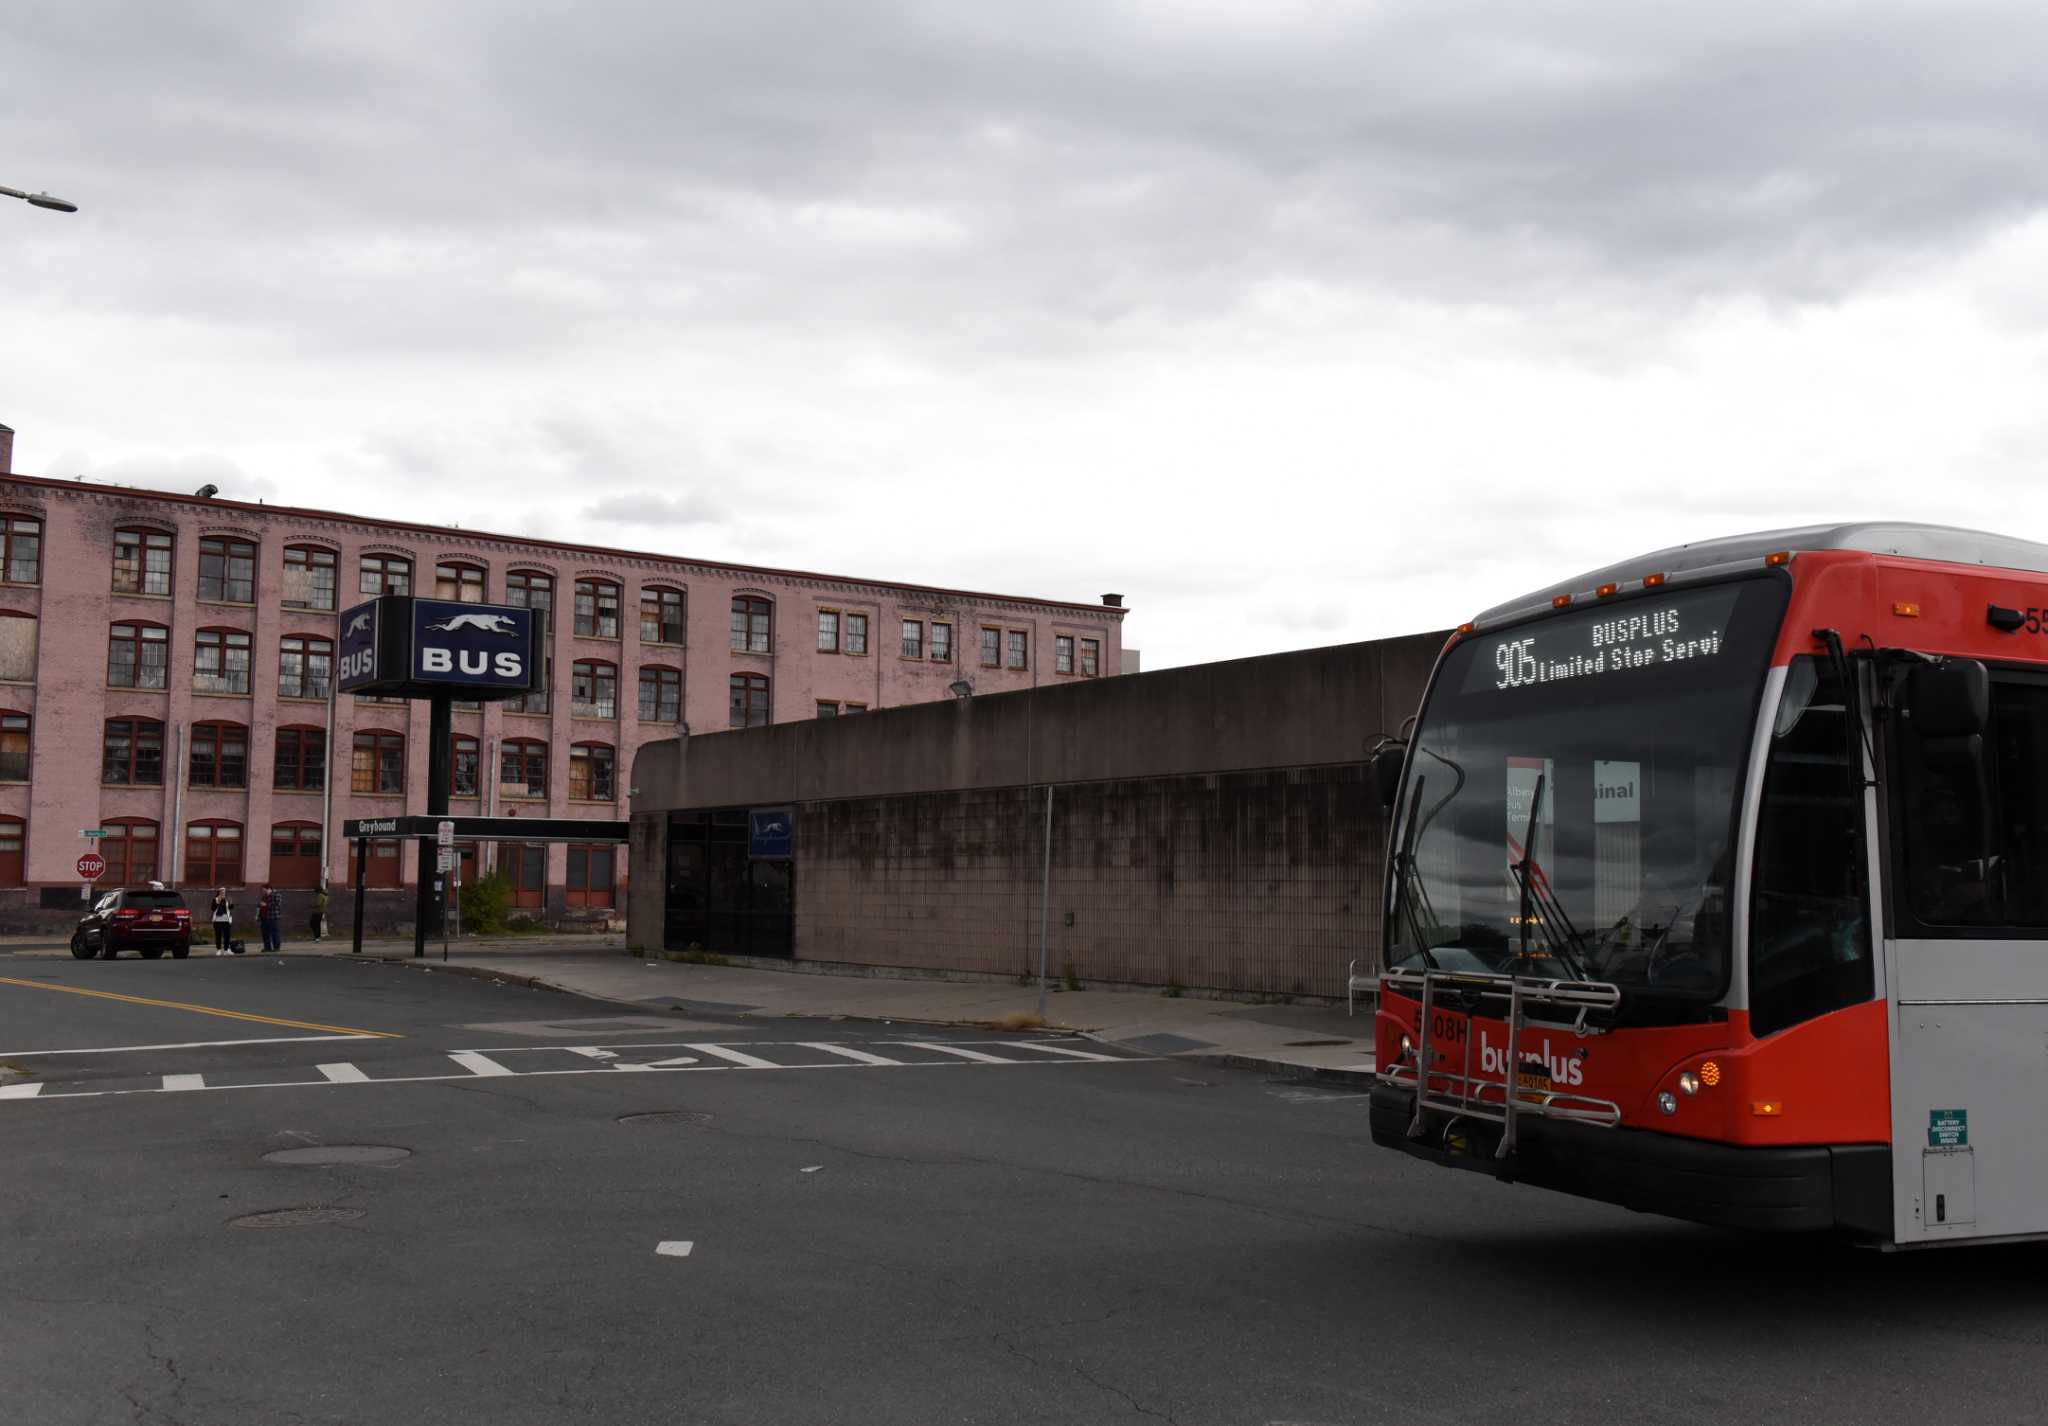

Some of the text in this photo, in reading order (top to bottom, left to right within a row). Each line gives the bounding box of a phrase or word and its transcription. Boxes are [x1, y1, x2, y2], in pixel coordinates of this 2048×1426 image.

[1592, 609, 1679, 647] BUSPLUS
[340, 648, 373, 681] BUS
[422, 647, 522, 678] BUS
[1496, 638, 1536, 689] 905
[1540, 630, 1722, 682] Limited Stop Servi
[1594, 781, 1634, 799] inal
[359, 819, 396, 834] Greyhound
[79, 861, 103, 872] STOP
[1414, 1008, 1467, 1043] 508H
